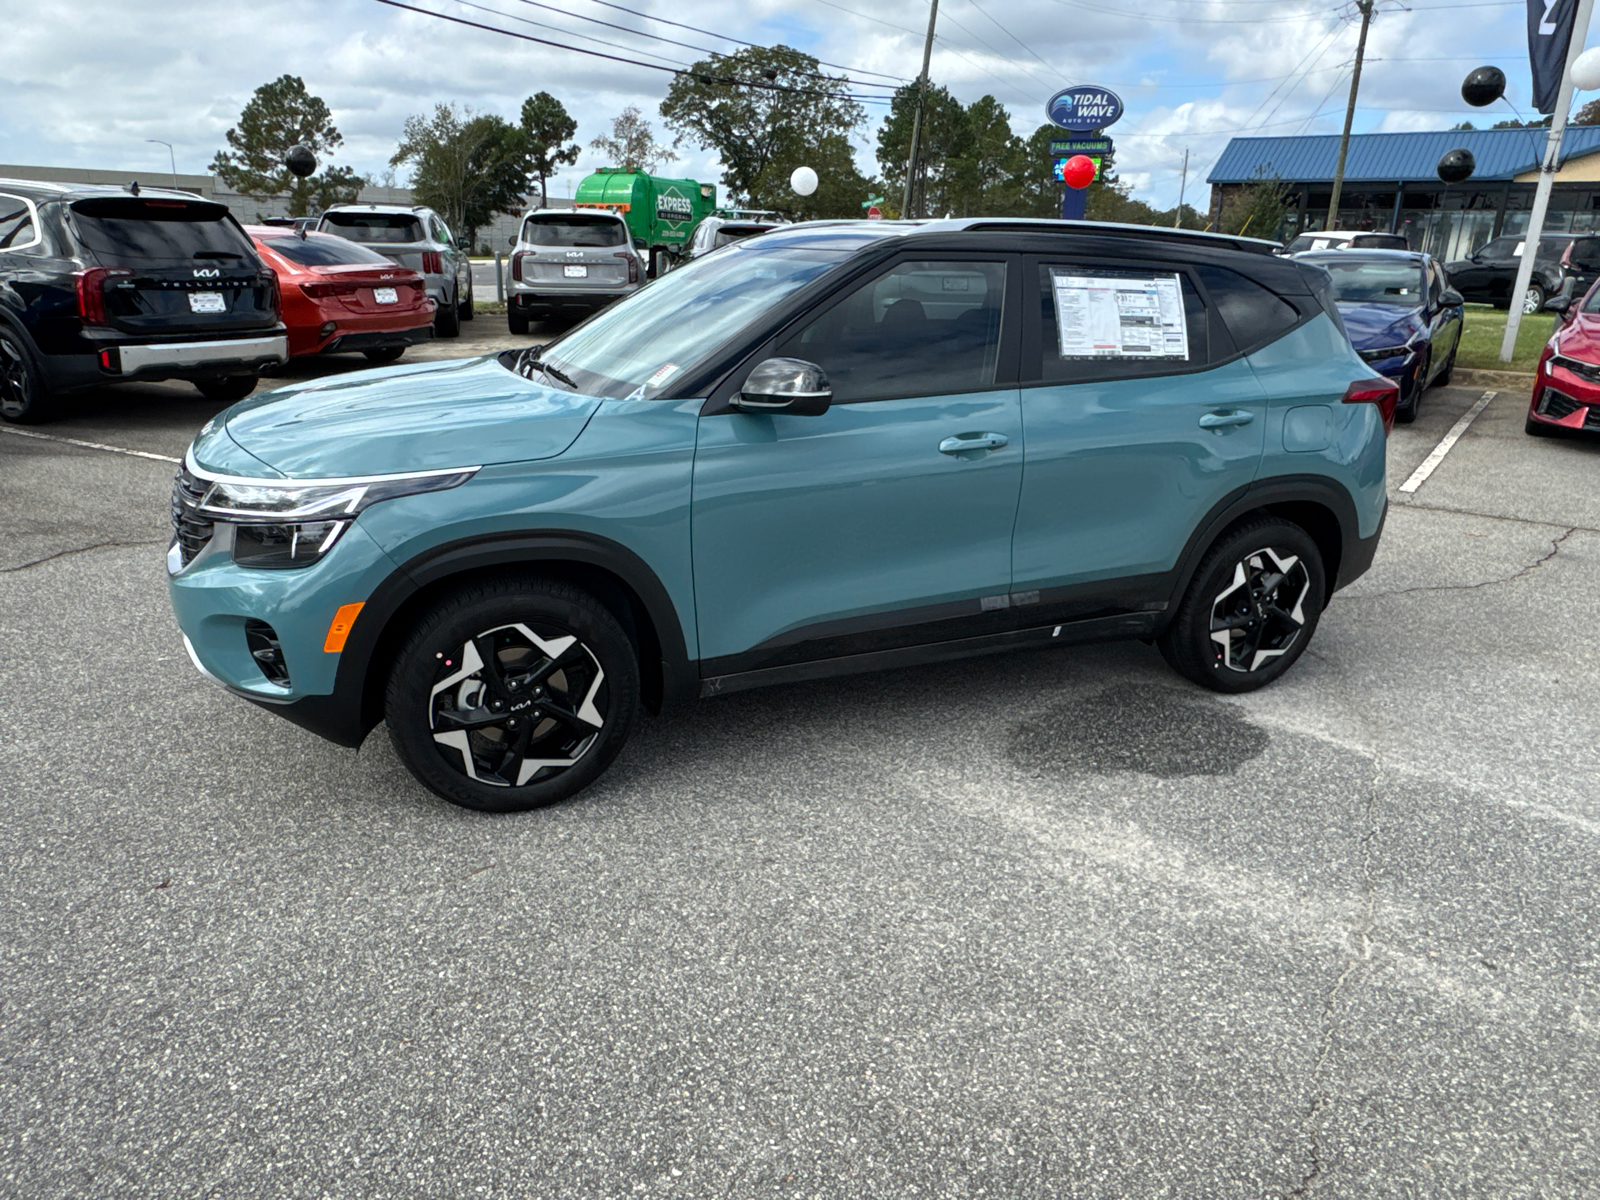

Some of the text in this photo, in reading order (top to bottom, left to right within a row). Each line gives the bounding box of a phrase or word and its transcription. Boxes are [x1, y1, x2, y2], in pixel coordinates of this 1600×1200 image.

[1073, 94, 1108, 105] TIDAL
[1077, 106, 1115, 117] WAVE
[1072, 141, 1107, 149] VACUUMS
[657, 194, 691, 212] EXPRESS
[193, 269, 220, 277] KIA
[510, 700, 531, 711] KIA
